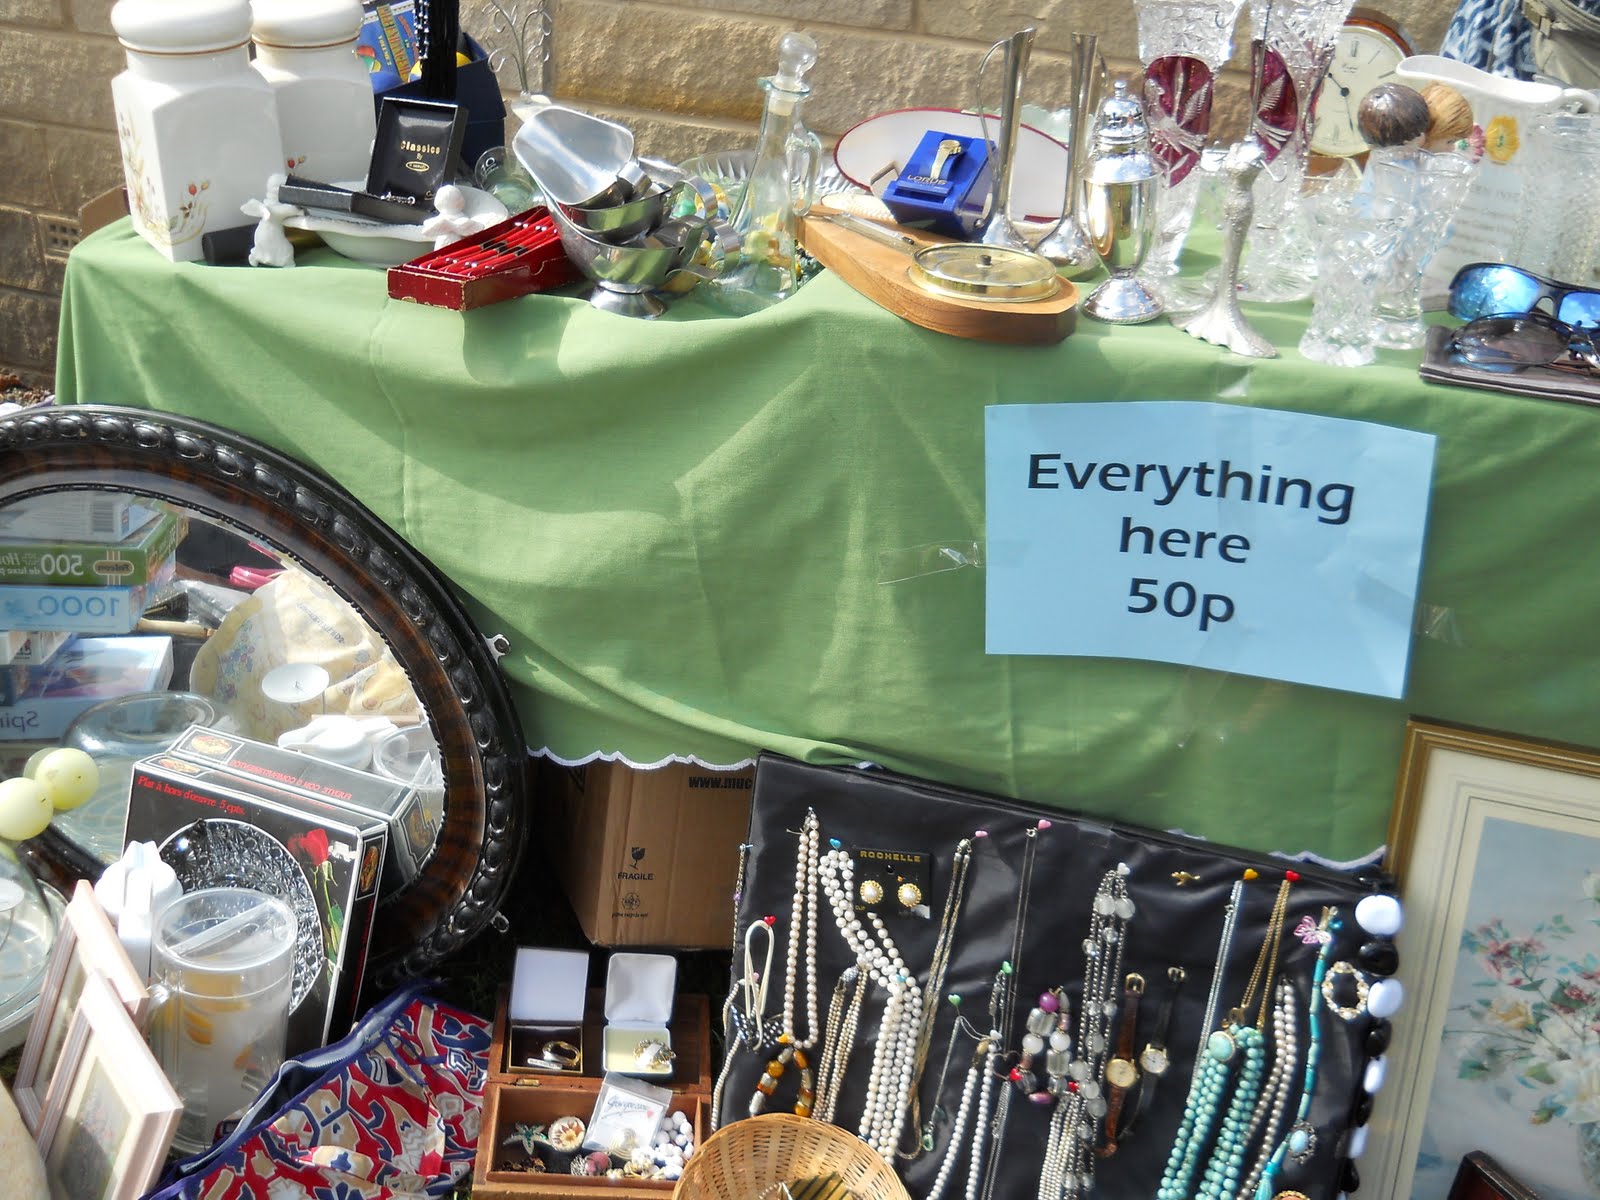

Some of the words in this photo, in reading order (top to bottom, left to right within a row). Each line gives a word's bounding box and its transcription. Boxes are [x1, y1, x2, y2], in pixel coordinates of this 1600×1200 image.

[400, 140, 441, 155] Classics
[907, 174, 947, 186] LORUS
[1027, 452, 1356, 526] Everything
[1119, 516, 1252, 564] here
[1127, 577, 1236, 632] 50p
[860, 850, 921, 863] ROCHELLE
[617, 871, 654, 881] FRAGILE
